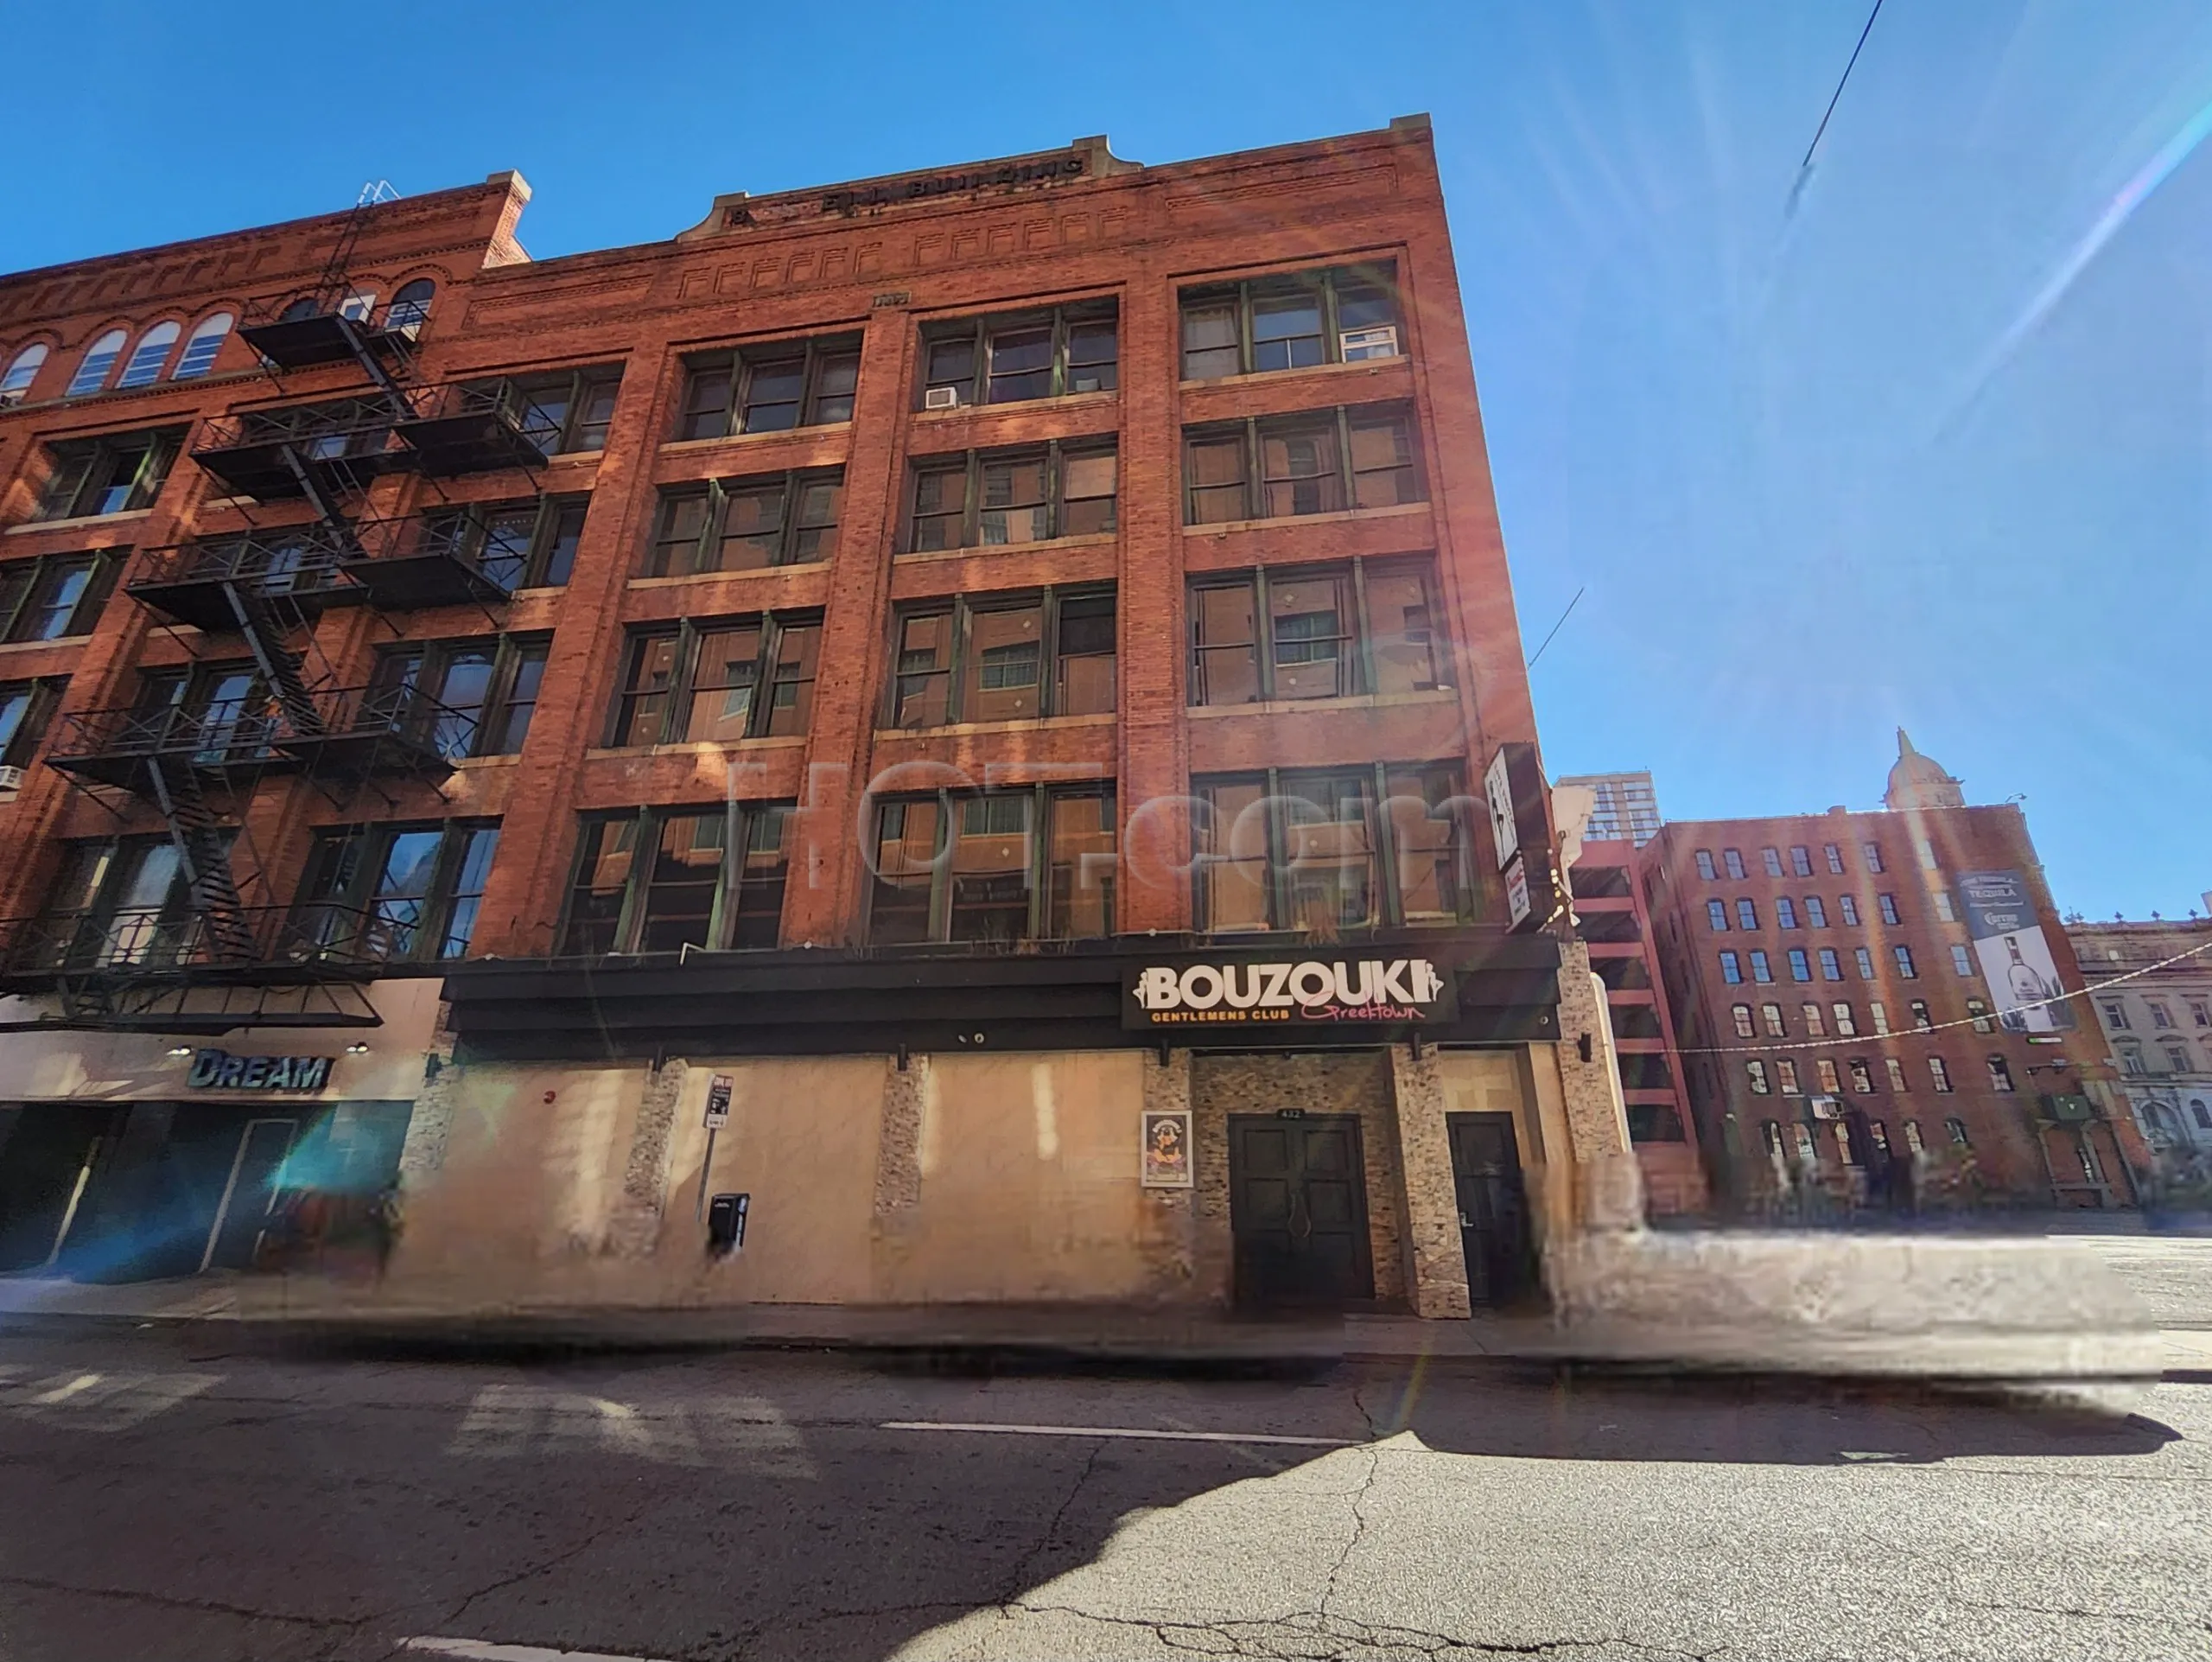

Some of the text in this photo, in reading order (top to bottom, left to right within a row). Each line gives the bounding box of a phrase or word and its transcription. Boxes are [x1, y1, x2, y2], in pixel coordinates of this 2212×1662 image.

[1146, 959, 1431, 1009] BOUZOUKI
[1152, 1009, 1290, 1022] GENTLEMENS CLUB
